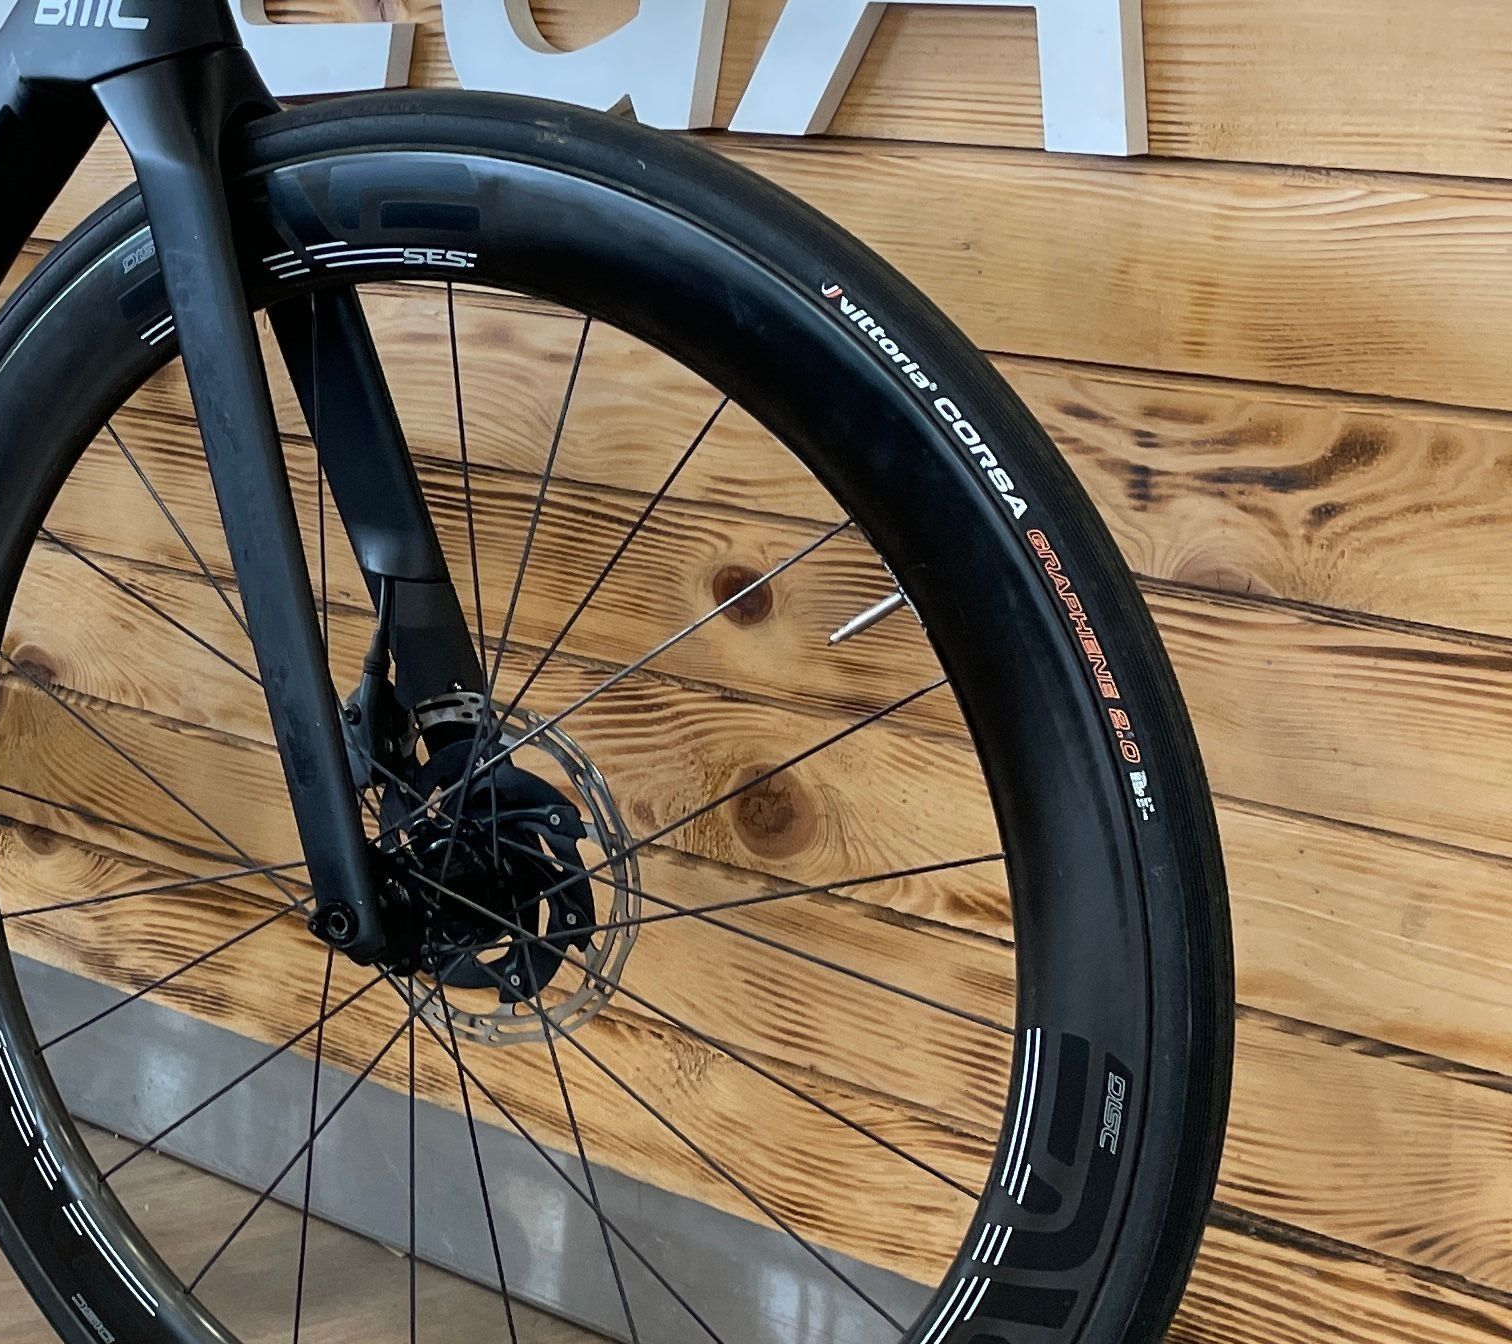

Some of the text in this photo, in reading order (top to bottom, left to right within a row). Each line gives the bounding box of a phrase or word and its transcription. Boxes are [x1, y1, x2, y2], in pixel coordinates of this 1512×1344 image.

[403, 247, 478, 268] SES
[839, 294, 1142, 765] vittoria CORSA GRAPHENE 2.0
[1098, 1071, 1126, 1155] DISC
